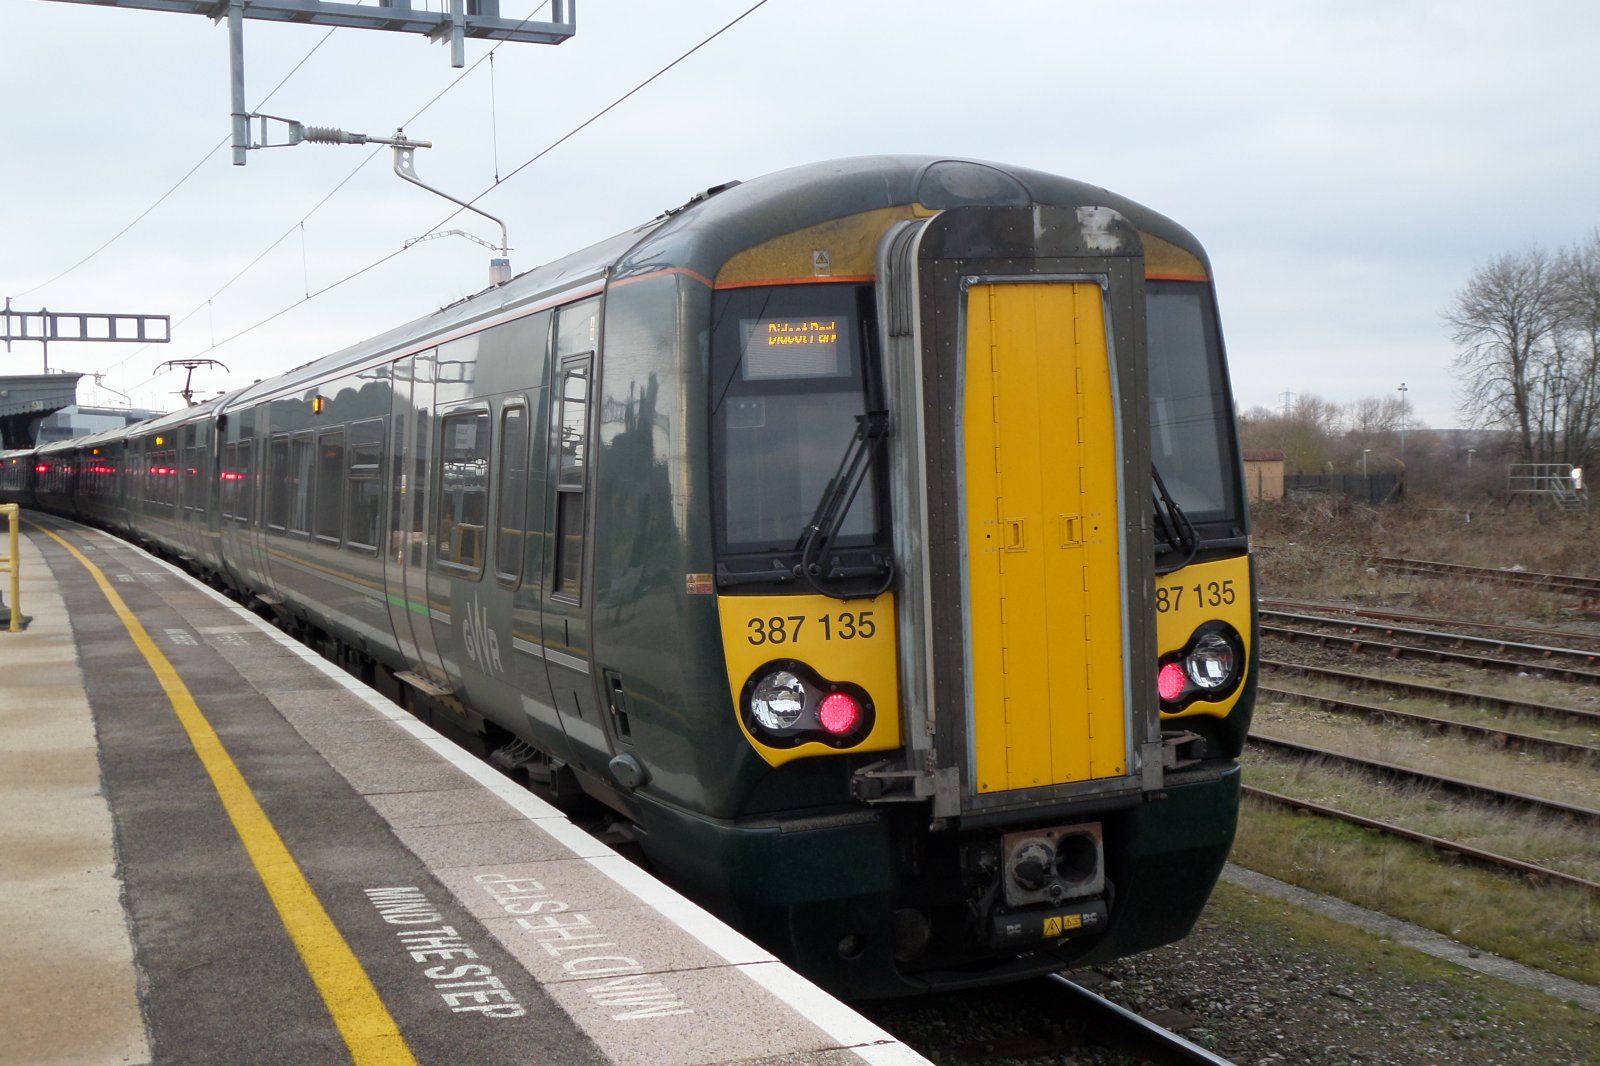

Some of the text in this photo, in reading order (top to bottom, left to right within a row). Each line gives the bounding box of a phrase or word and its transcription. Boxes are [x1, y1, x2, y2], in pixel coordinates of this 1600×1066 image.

[462, 591, 504, 676] GWR
[747, 611, 876, 646] 387 135
[1193, 580, 1236, 608] 135
[363, 886, 528, 1019] MIND THE STEP
[473, 873, 695, 1022] MIND THE STEP
